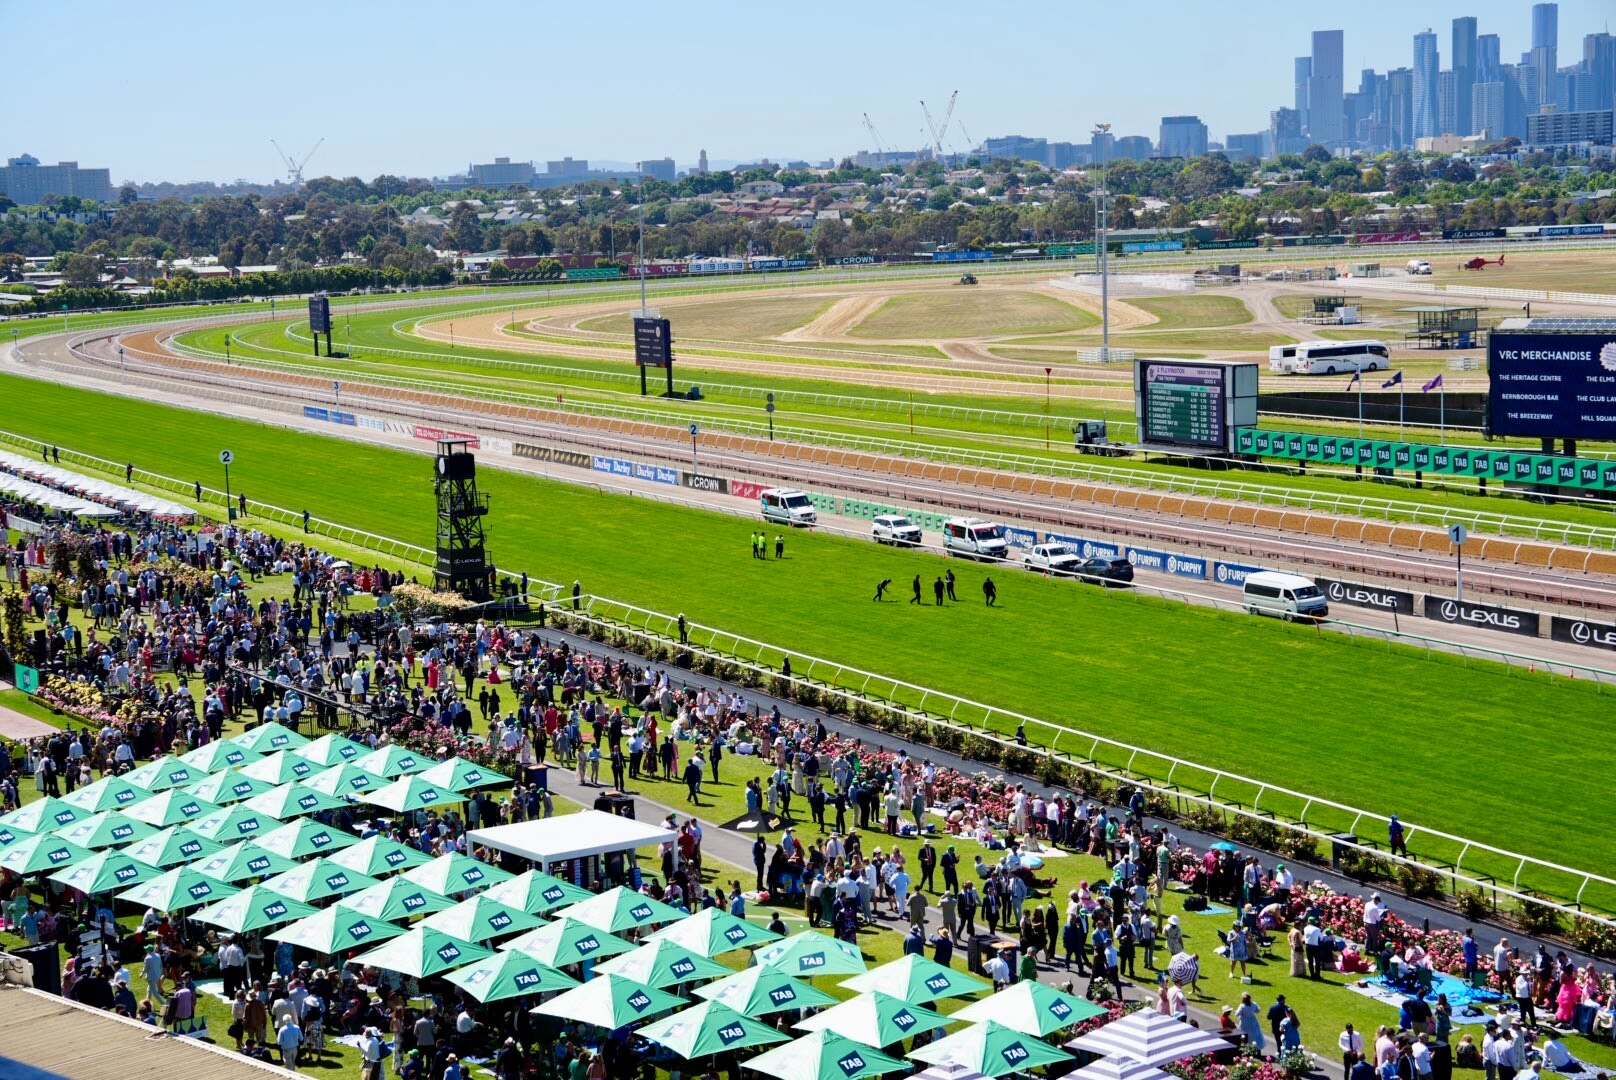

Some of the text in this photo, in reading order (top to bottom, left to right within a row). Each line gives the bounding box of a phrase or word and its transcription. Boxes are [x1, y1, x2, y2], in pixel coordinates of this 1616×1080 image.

[843, 256, 874, 264] CROWN
[1499, 350, 1518, 359] VRC
[1521, 351, 1591, 361] MERCHANDISE
[334, 381, 338, 389] 3
[690, 424, 697, 435] 2
[222, 451, 230, 462] 2
[1241, 436, 1251, 446] TAB
[1257, 438, 1268, 448] TAB
[1274, 440, 1284, 449] TAB
[1290, 442, 1301, 451] TAB
[1307, 443, 1318, 452] TAB
[1324, 445, 1335, 455] TAB
[1342, 447, 1353, 456] TAB
[1360, 448, 1371, 458] TAB
[1378, 450, 1389, 460] TAB
[1397, 452, 1408, 461] TAB
[1415, 454, 1428, 463] TAB
[1435, 455, 1447, 465] TAB
[1455, 457, 1467, 467] TAB
[1475, 459, 1487, 469] TAB
[1495, 461, 1508, 471] TAB
[1517, 463, 1529, 473] TAB
[1538, 465, 1551, 475] TAB
[1560, 467, 1573, 478] TAB
[1582, 469, 1596, 479] TAB
[594, 457, 675, 484] Darley Darley Darley Darley
[695, 476, 719, 491] CROWN
[1452, 526, 1460, 542] 1
[1093, 547, 1114, 557] FURPHY
[1137, 554, 1161, 567] FURPHY
[1177, 560, 1202, 574] FURPHY
[1228, 570, 1252, 581] FURP
[1346, 587, 1397, 607] LEXUS
[1460, 607, 1520, 628] LEXUS
[272, 737, 288, 745] TAB
[341, 747, 356, 755] TAB
[227, 753, 243, 761] TAB
[399, 759, 415, 767] TAB
[171, 772, 188, 780] TAB
[352, 777, 368, 785] TAB
[234, 784, 251, 792] TAB
[117, 791, 134, 800] TAB
[420, 791, 437, 799] TAB
[300, 797, 317, 806] TAB
[182, 805, 199, 813] TAB
[56, 813, 74, 821] TAB
[239, 821, 258, 829] TAB
[113, 827, 132, 836] TAB
[312, 835, 330, 844] TAB
[182, 843, 200, 852] TAB
[50, 851, 70, 860] TAB
[387, 853, 405, 862] TAB
[249, 859, 269, 868] TAB
[116, 868, 136, 878] TAB
[464, 870, 482, 880] TAB
[328, 876, 347, 885] TAB
[190, 885, 210, 894] TAB
[544, 889, 562, 899] TAB
[404, 897, 424, 906] TAB
[265, 905, 286, 915] TAB
[632, 907, 651, 916] TAB
[490, 915, 510, 926] TAB
[350, 925, 370, 935] TAB
[726, 929, 745, 939] TAB
[577, 939, 598, 950] TAB
[439, 947, 458, 958] TAB
[801, 956, 824, 965] TAB
[672, 962, 694, 973] TAB
[516, 973, 539, 984] TAB
[927, 977, 948, 988] TAB
[771, 989, 794, 1000] TAB
[629, 995, 649, 1006] TAB
[1051, 1003, 1070, 1014] TAB
[894, 1013, 914, 1026] TAB
[720, 1027, 744, 1038] TAB
[1004, 1047, 1027, 1060] TAB
[840, 1057, 864, 1069] TAB
